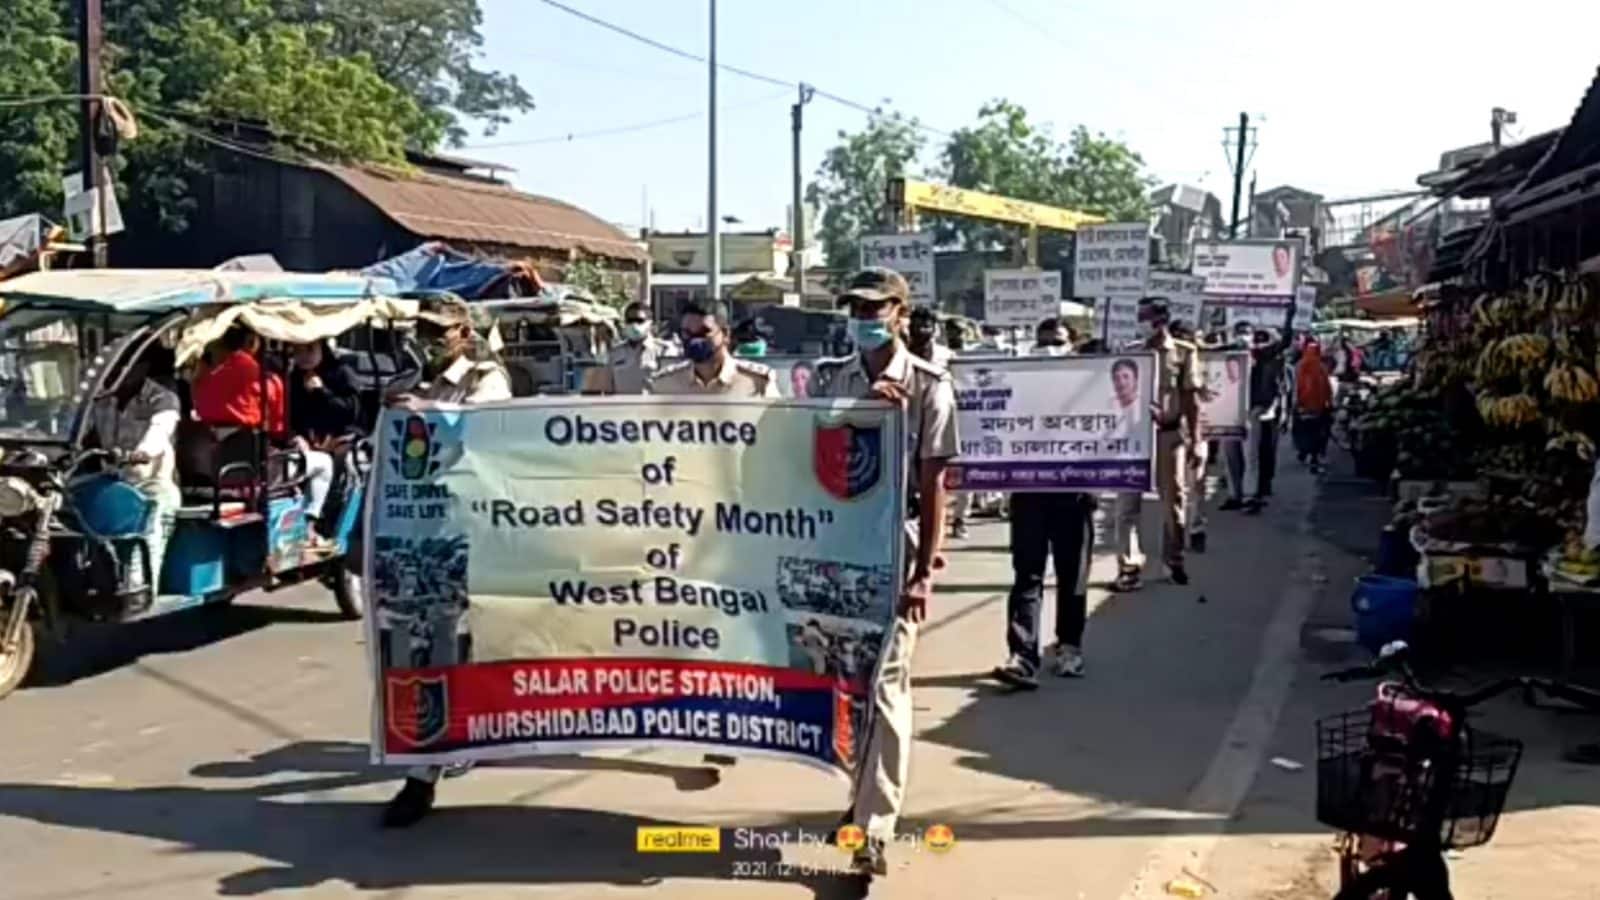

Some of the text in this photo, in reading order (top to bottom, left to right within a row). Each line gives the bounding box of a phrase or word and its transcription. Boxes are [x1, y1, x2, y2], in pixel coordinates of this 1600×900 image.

[544, 414, 757, 446] Observance
[1010, 439, 1099, 456] চালাবেন
[641, 456, 677, 486] of
[596, 498, 704, 536] Safety
[645, 543, 681, 570] of
[549, 576, 769, 616] West Bengal
[613, 618, 721, 650] Police
[513, 668, 781, 710] SALAR POLICE STATION,
[467, 707, 822, 750] MURSHIDABAD POLICE DISTRICT
